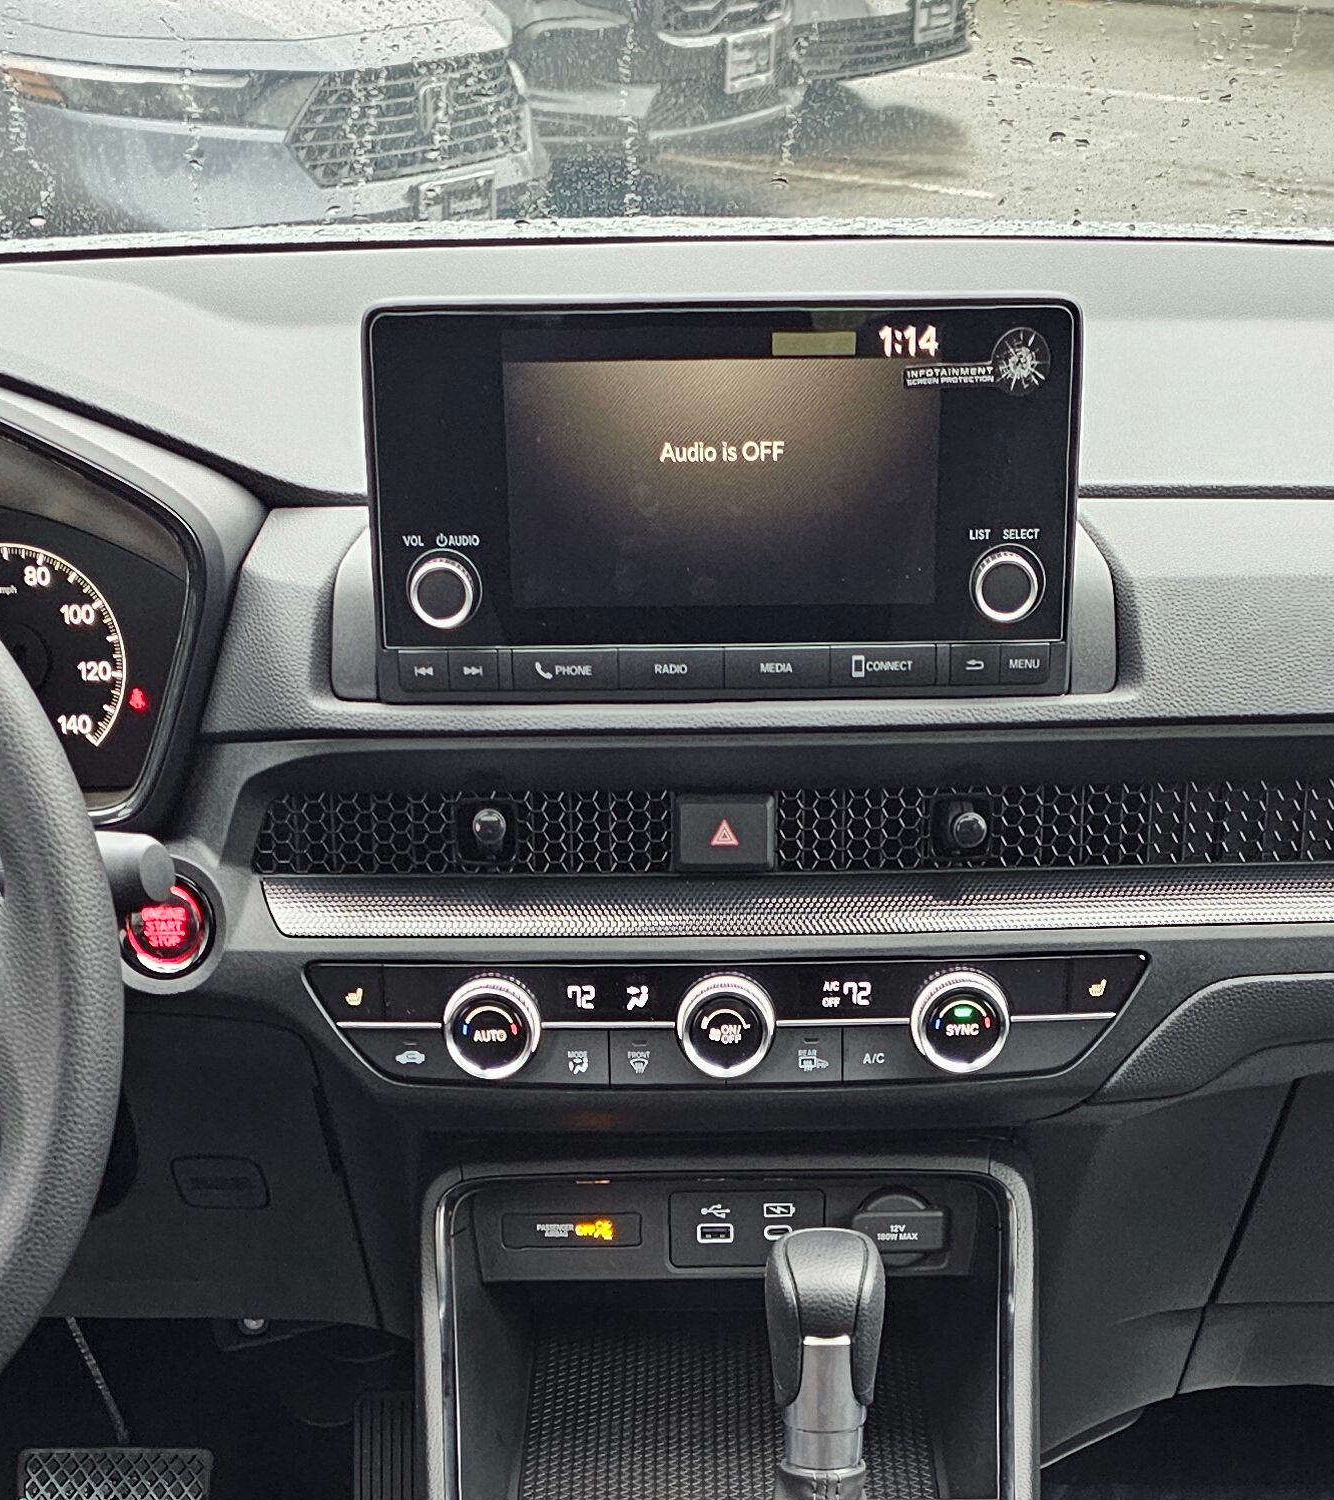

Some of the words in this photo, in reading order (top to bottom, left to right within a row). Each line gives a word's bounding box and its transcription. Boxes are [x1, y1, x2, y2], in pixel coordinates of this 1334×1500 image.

[879, 325, 940, 358] 1:14
[907, 366, 993, 378] INFOTAINMENT
[907, 377, 939, 386] SCREEN
[940, 375, 994, 384] PROTECTION
[659, 441, 716, 463] Audio
[722, 441, 737, 462] is
[742, 441, 785, 462] OFF
[969, 529, 991, 540] LIST
[1002, 528, 1040, 540] SELECT
[403, 535, 424, 547] VOL
[448, 534, 480, 547] AUDIO
[23, 566, 51, 587] 80
[0, 585, 17, 595] mph
[60, 604, 95, 625] 100
[654, 664, 688, 675] RADIO
[760, 662, 793, 673] MEDIA
[866, 660, 913, 672] CONNECT
[1009, 659, 1040, 669] MENU
[77, 661, 112, 681] 120
[555, 665, 592, 676] PHONE
[57, 714, 92, 735] 140
[142, 906, 186, 921] ENGINE
[145, 921, 184, 932] START
[149, 936, 182, 947] STOP
[567, 985, 596, 1009] 72
[843, 981, 872, 1006] 72
[473, 1030, 507, 1042] AUTO
[945, 1023, 980, 1037] SYNC
[863, 1053, 885, 1064] A/C
[536, 1223, 574, 1231] PASSENGER
[889, 1224, 906, 1232] 12V
[899, 1232, 919, 1240] MAX
